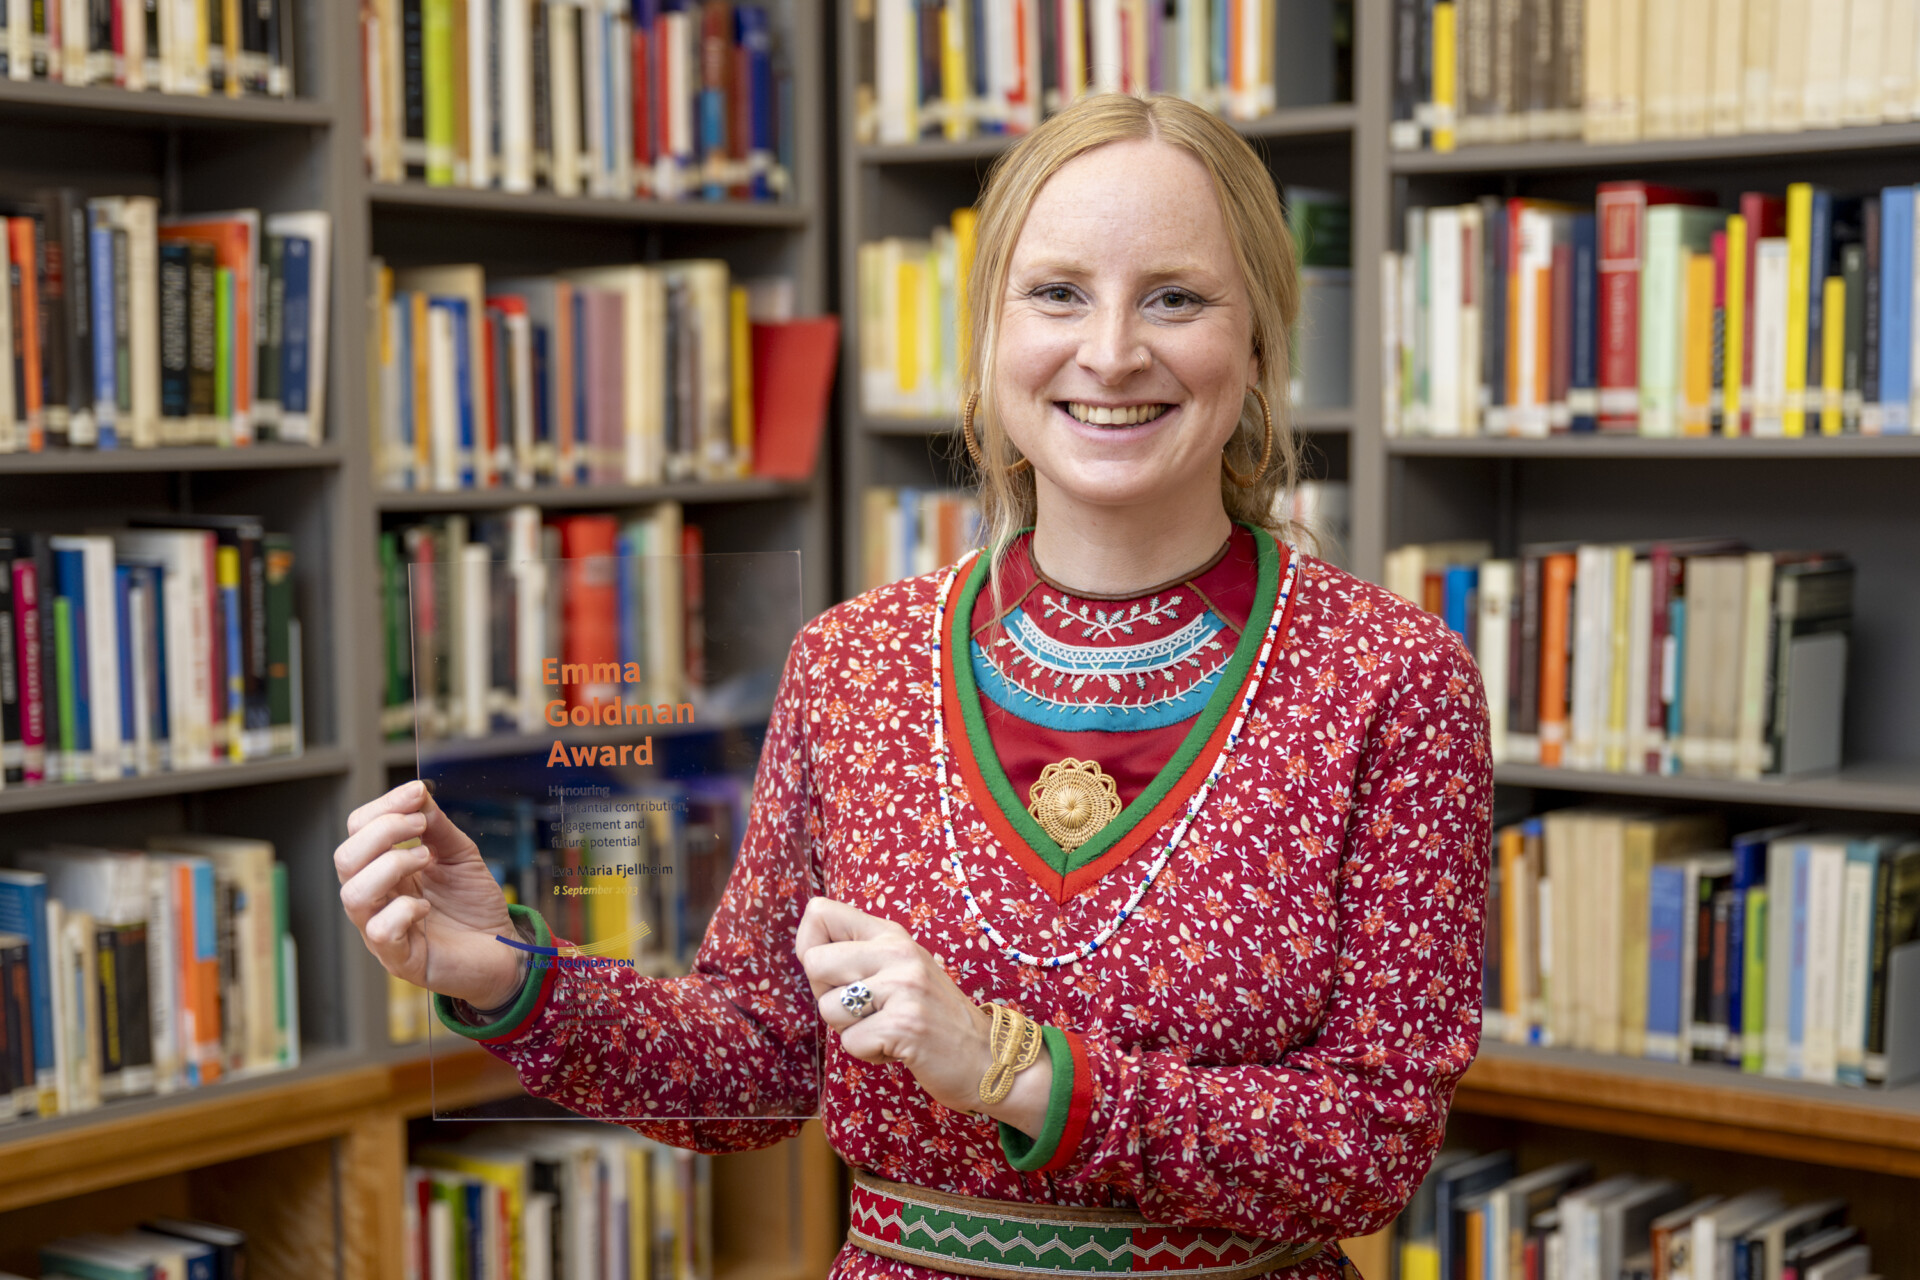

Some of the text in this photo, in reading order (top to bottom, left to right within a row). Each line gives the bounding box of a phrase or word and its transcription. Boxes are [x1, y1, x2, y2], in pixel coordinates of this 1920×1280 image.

[542, 657, 641, 685] Emma
[544, 696, 695, 727] Goldman
[546, 736, 654, 767] Award
[548, 784, 610, 798] Honouring
[615, 801, 689, 813] contribution,
[550, 818, 645, 833] engagement and
[551, 835, 641, 850] future potential
[552, 863, 673, 878] Eva Maria Fjellheim
[553, 885, 560, 896] 8
[562, 885, 613, 897] September
[558, 959, 635, 968] FOUNDATION
